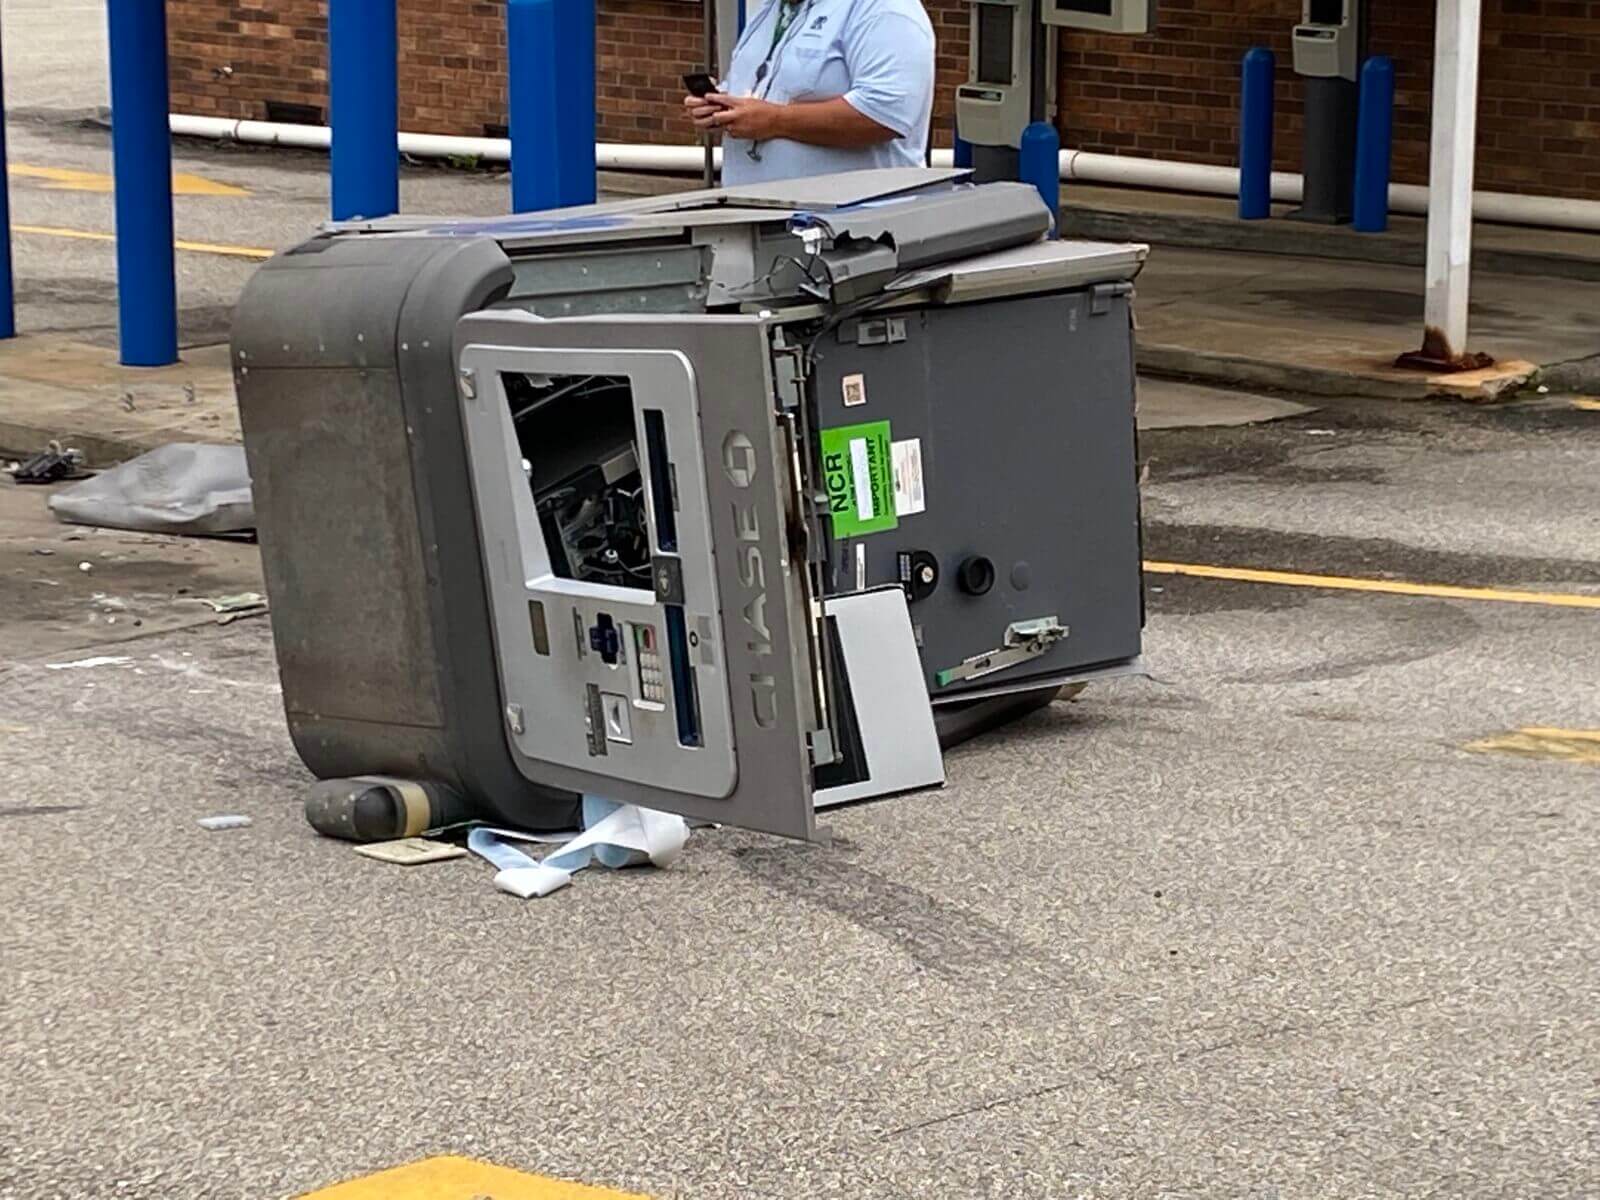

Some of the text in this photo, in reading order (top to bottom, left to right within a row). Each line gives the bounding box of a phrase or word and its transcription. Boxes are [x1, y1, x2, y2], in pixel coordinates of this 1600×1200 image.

[826, 452, 849, 513] NCR
[865, 437, 881, 517] IMPORTANT
[731, 502, 777, 729] CHASE
